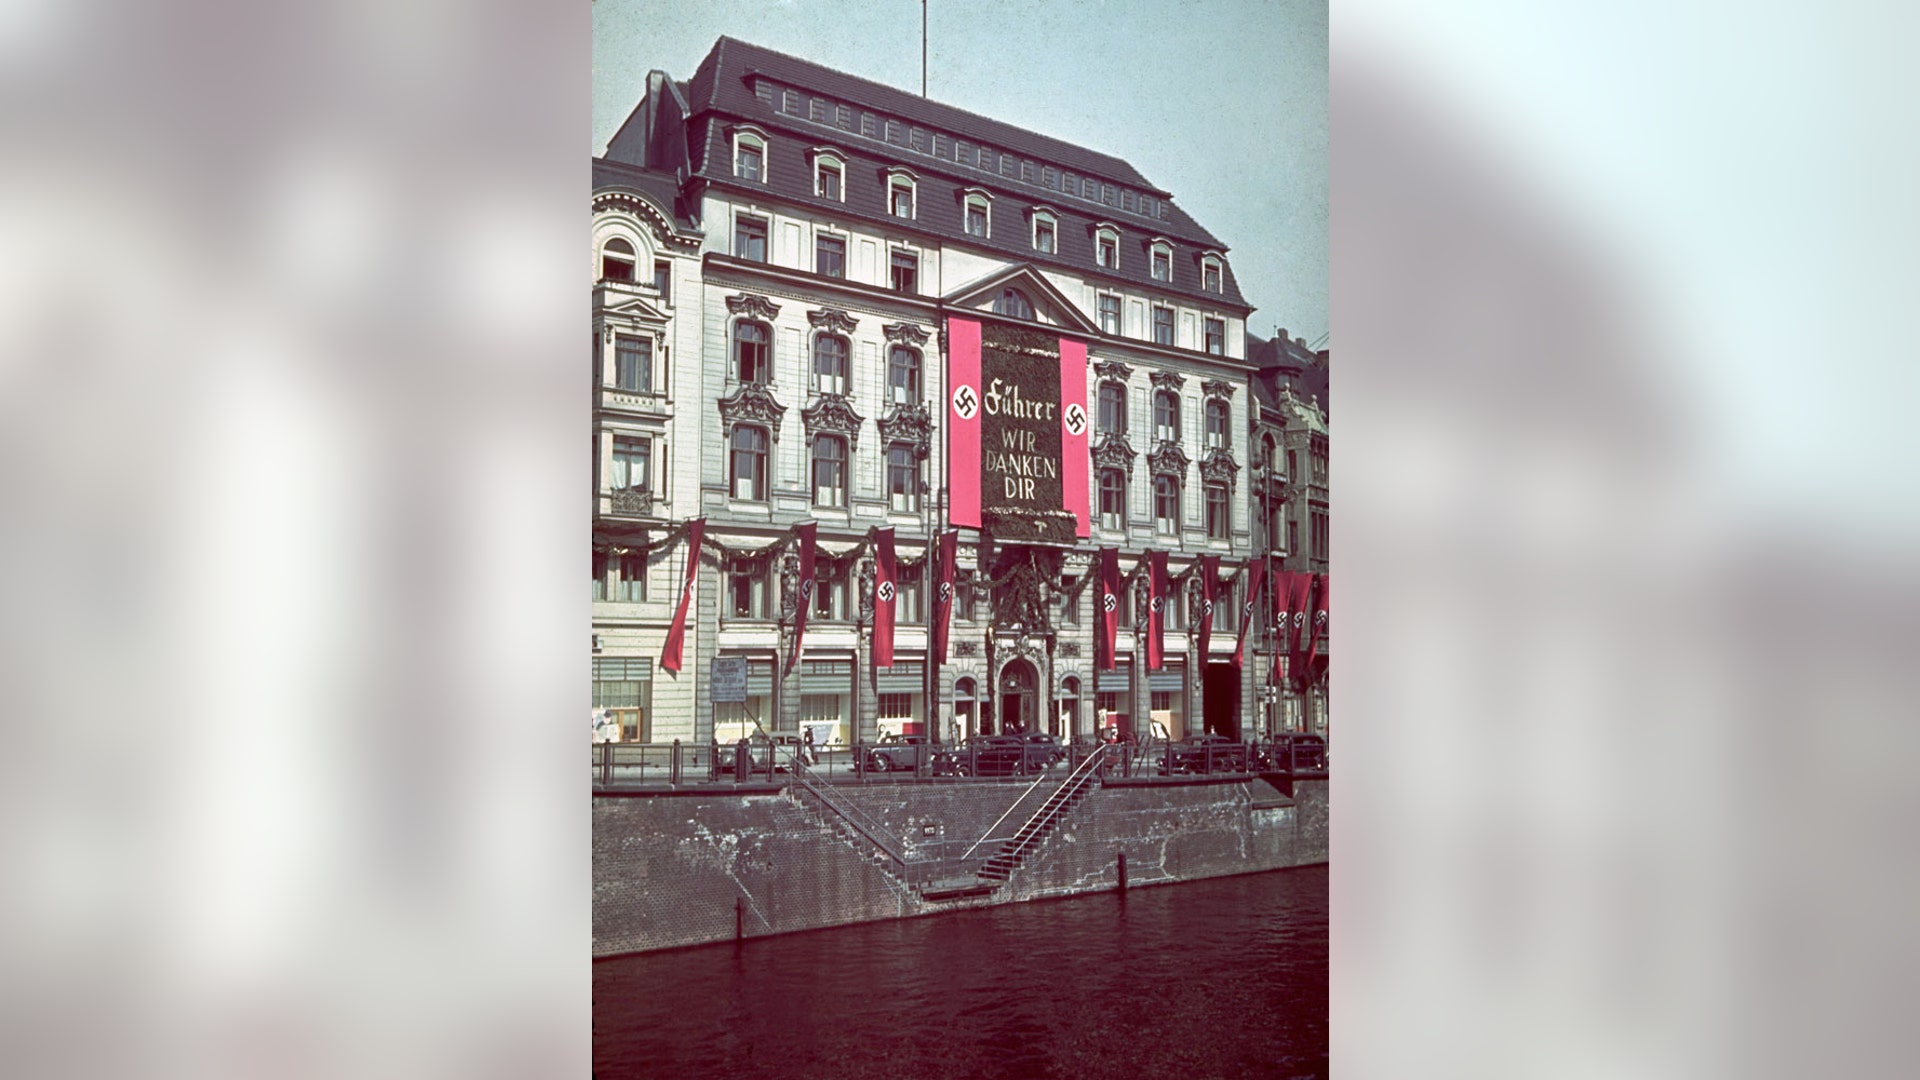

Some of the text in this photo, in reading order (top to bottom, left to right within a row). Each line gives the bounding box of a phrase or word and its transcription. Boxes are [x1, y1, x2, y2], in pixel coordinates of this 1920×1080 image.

[984, 377, 1056, 420] Führer
[1001, 428, 1036, 452] WIR
[985, 450, 1056, 479] DANKEN
[1004, 478, 1035, 500] DIR
